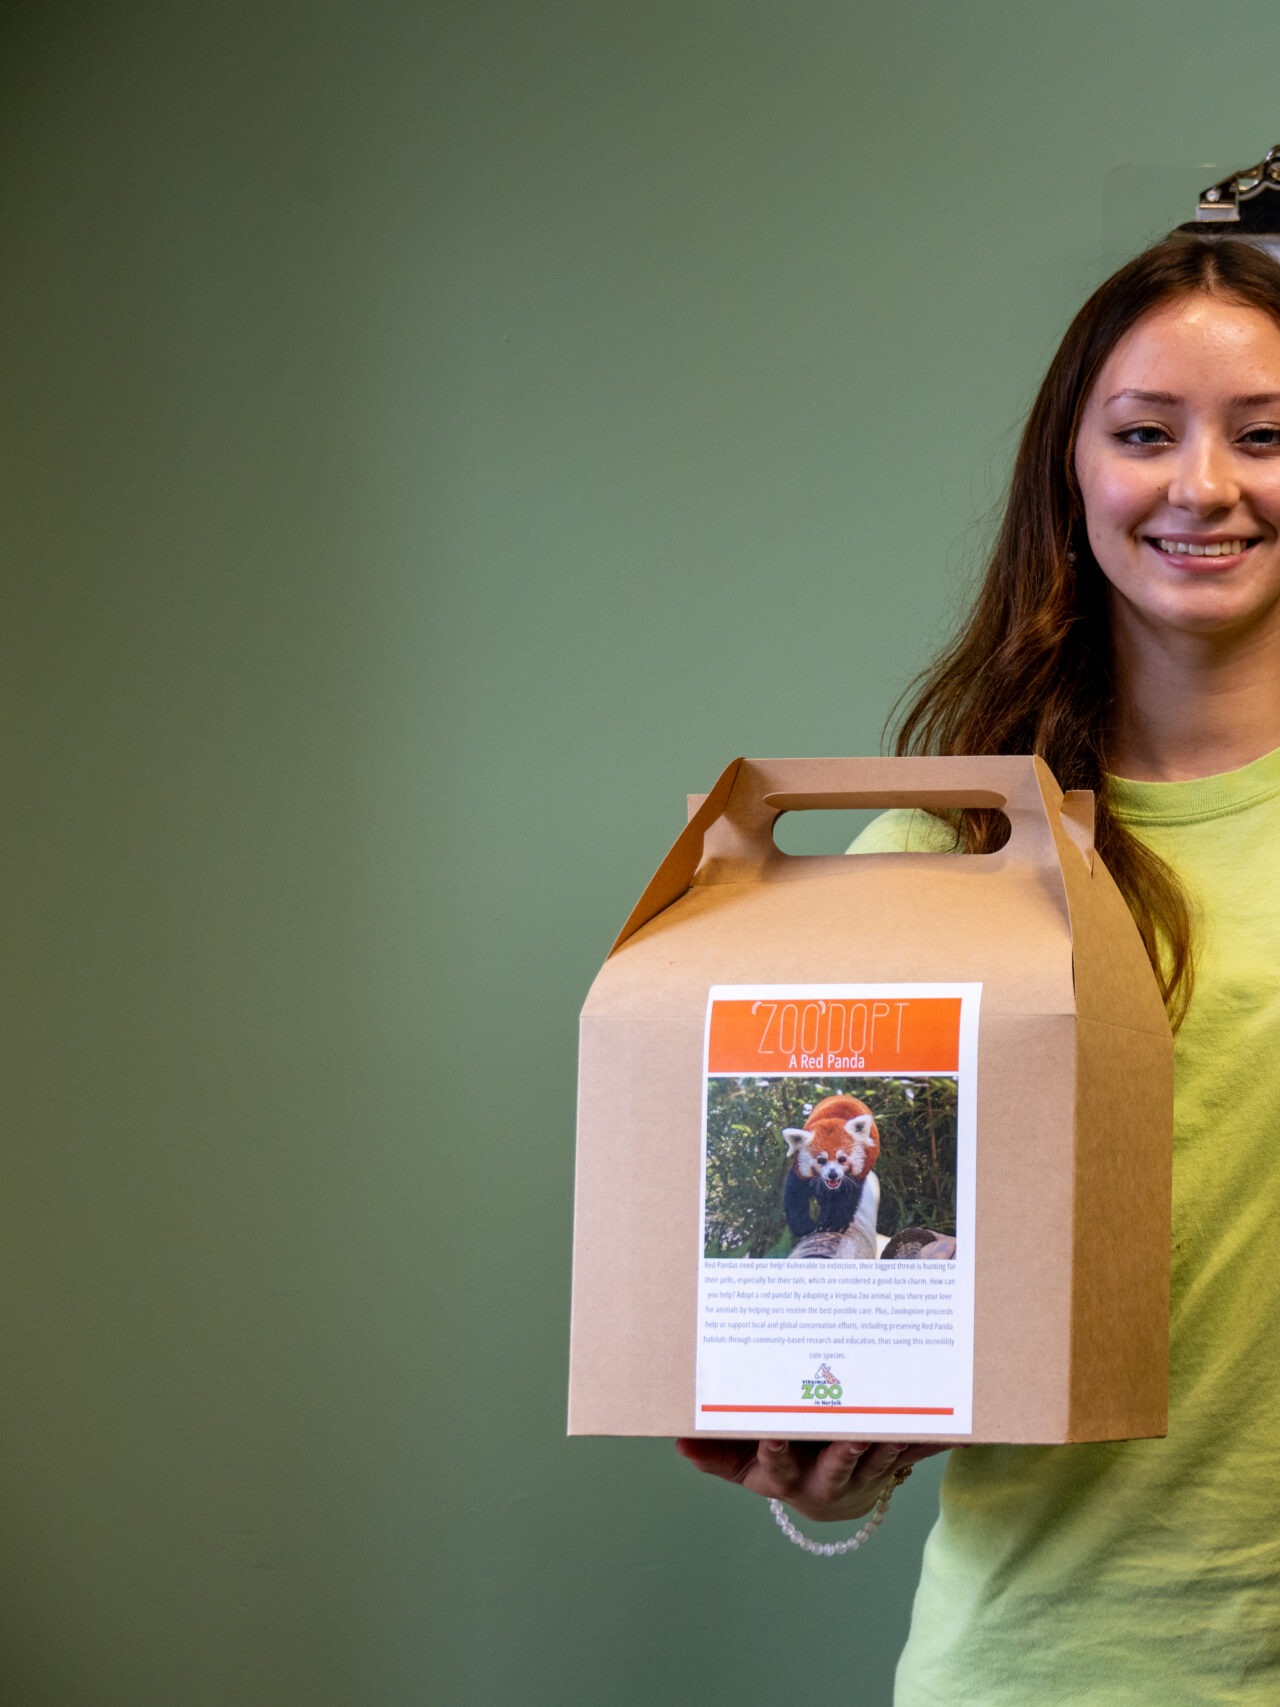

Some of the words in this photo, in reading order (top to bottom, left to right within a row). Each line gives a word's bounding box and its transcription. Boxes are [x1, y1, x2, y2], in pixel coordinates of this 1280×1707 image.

[789, 1054, 798, 1068] A
[802, 1054, 824, 1068] Red
[828, 1054, 865, 1069] Panda
[827, 1262, 857, 1271] extinction,
[875, 1262, 896, 1272] biggest
[923, 1263, 946, 1272] hunting
[737, 1277, 766, 1286] especially
[877, 1277, 906, 1287] good-luck
[707, 1292, 718, 1300] you
[719, 1291, 735, 1300] help?
[736, 1291, 754, 1300] Adopt
[772, 1292, 792, 1301] panda!
[794, 1292, 801, 1301] By
[802, 1292, 829, 1301] adopting
[835, 1292, 857, 1301] Virginia
[870, 1292, 893, 1301] animal,
[739, 1306, 747, 1316] by
[748, 1306, 770, 1316] helping
[833, 1306, 857, 1316] possible
[926, 1307, 953, 1316] proceeds
[705, 1321, 718, 1331] help
[727, 1321, 751, 1331] support
[779, 1322, 798, 1331] global
[860, 1322, 888, 1332] including
[889, 1322, 920, 1332] preserving
[728, 1336, 751, 1346] through
[752, 1336, 805, 1346] community-based
[846, 1337, 877, 1346] education,
[892, 1337, 911, 1347] saving
[925, 1338, 954, 1347] incredibly
[801, 1384, 842, 1399] ZOO
